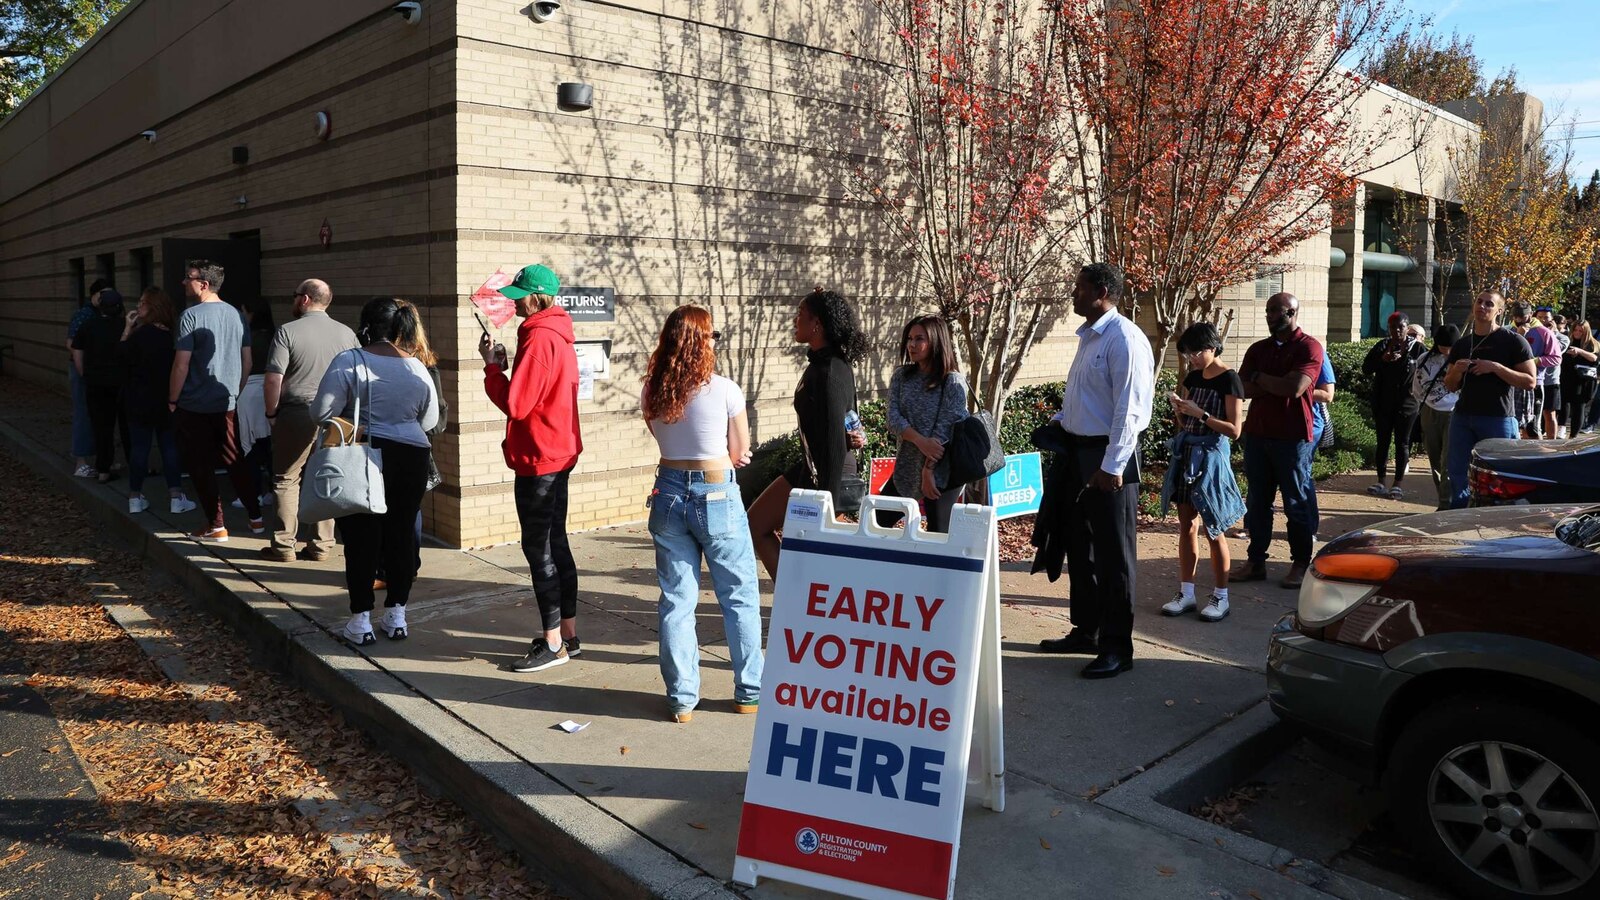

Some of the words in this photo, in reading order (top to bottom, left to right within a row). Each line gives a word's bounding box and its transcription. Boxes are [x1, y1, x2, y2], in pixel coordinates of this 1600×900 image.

[554, 296, 604, 306] RETURNS
[998, 489, 1031, 505] ACCESS
[806, 582, 944, 632] EARLY
[784, 628, 956, 686] VOTING
[775, 682, 951, 732] available
[766, 721, 946, 807] HERE
[819, 843, 862, 856] REGISTRATION
[820, 833, 852, 846] FULTON
[853, 840, 887, 854] COUNTY
[824, 850, 856, 862] ELECTIONS
